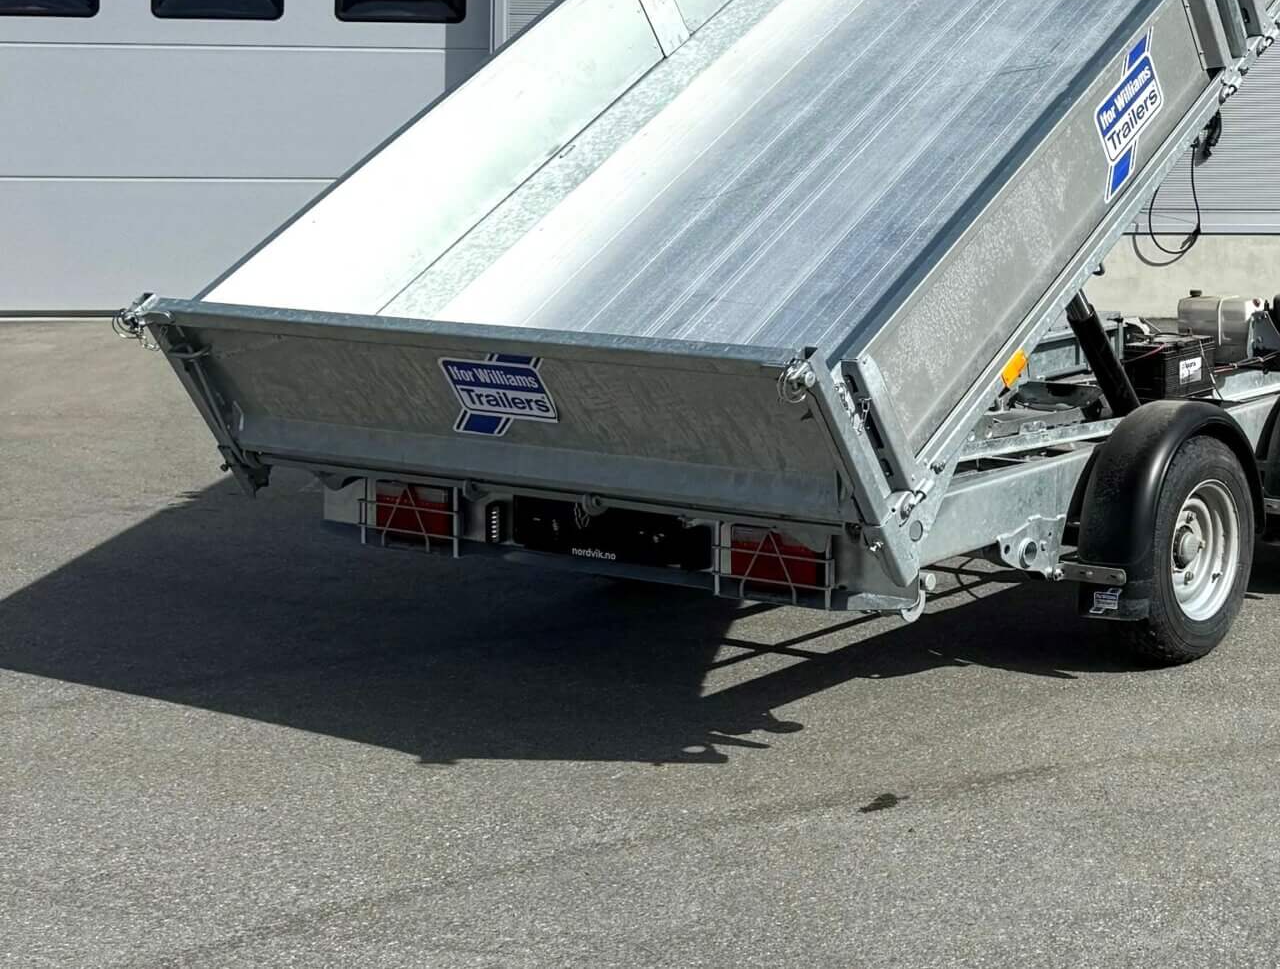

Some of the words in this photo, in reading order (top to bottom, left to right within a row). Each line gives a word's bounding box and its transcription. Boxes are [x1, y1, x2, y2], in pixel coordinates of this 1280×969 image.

[1100, 105, 1117, 130] Ifor
[1114, 66, 1151, 112] Williams
[1107, 89, 1158, 150] Trailers
[448, 365, 476, 382] Ifor
[472, 368, 539, 389] Williams
[459, 388, 551, 413] Trailers
[571, 547, 617, 561] nordvik.no
